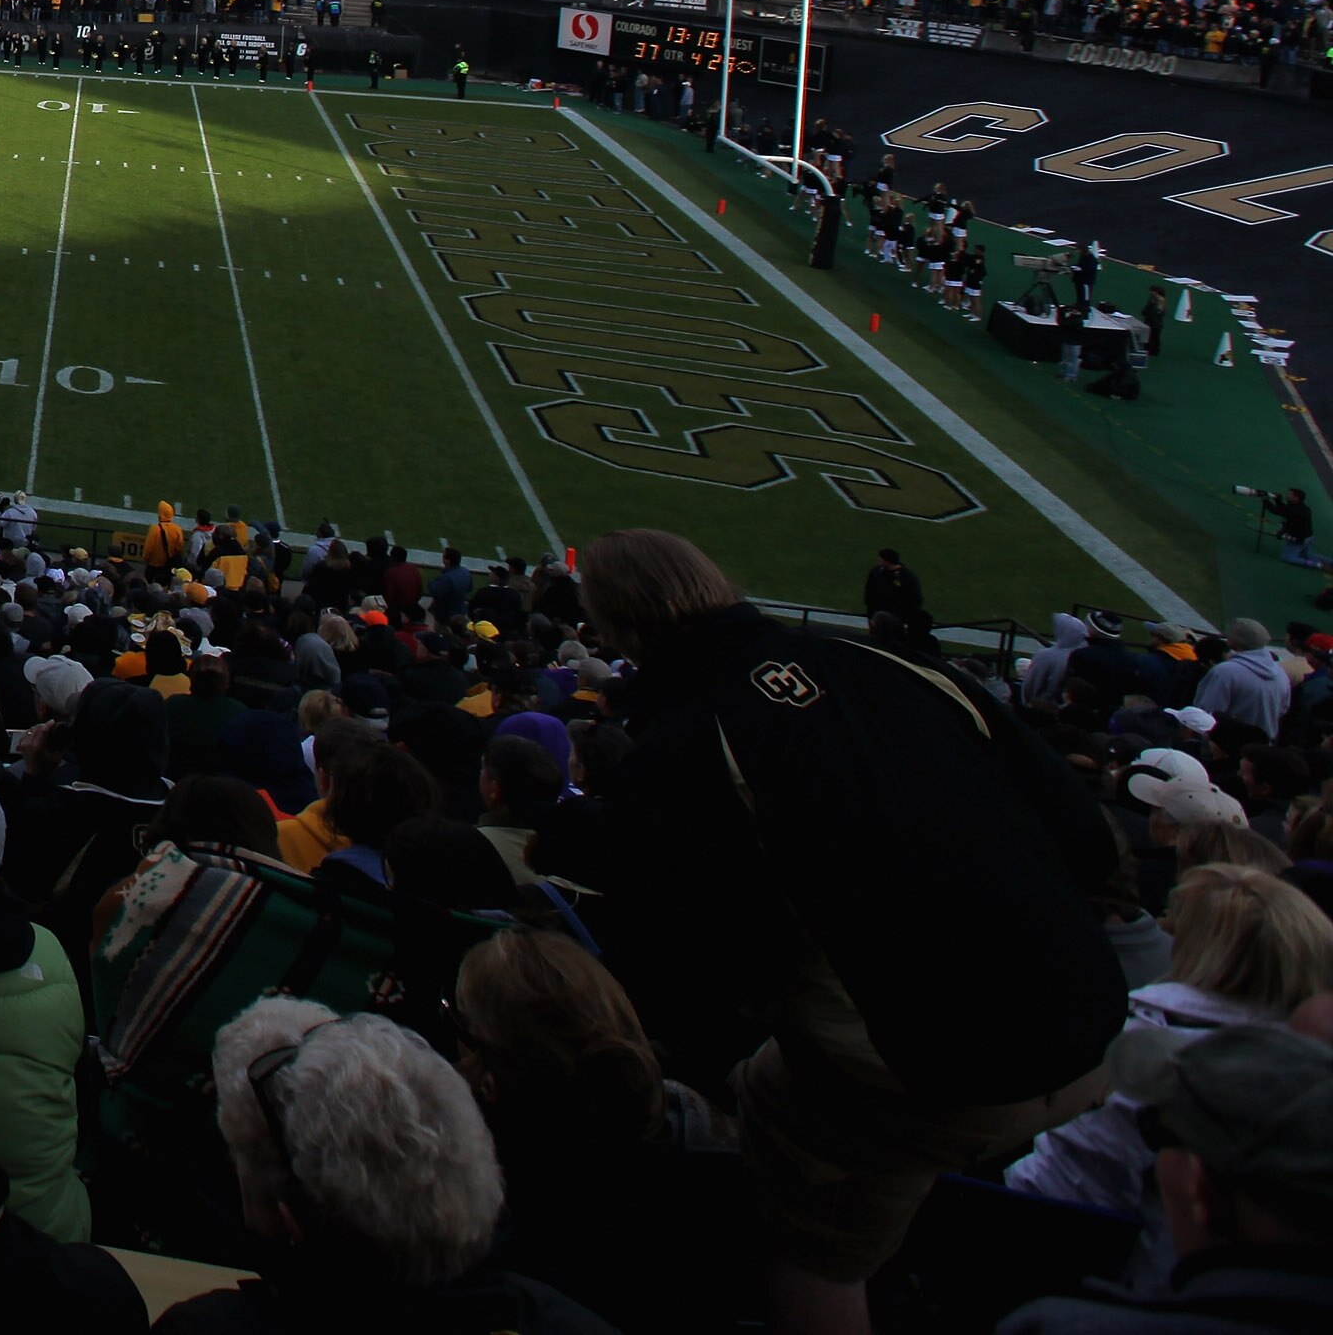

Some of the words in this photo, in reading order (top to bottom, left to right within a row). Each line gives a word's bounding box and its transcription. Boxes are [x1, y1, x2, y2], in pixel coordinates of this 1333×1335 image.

[76, 25, 91, 38] 10
[614, 20, 657, 36] COLORADO
[569, 40, 598, 50] SAFEWAY
[666, 26, 721, 49] 13:18
[634, 42, 661, 60] 37
[664, 49, 684, 62] QTR
[691, 52, 702, 65] 4
[1066, 43, 1178, 76] COLORADO
[36, 100, 109, 113] 10
[121, 541, 144, 556] 10
[750, 660, 821, 708] CU
